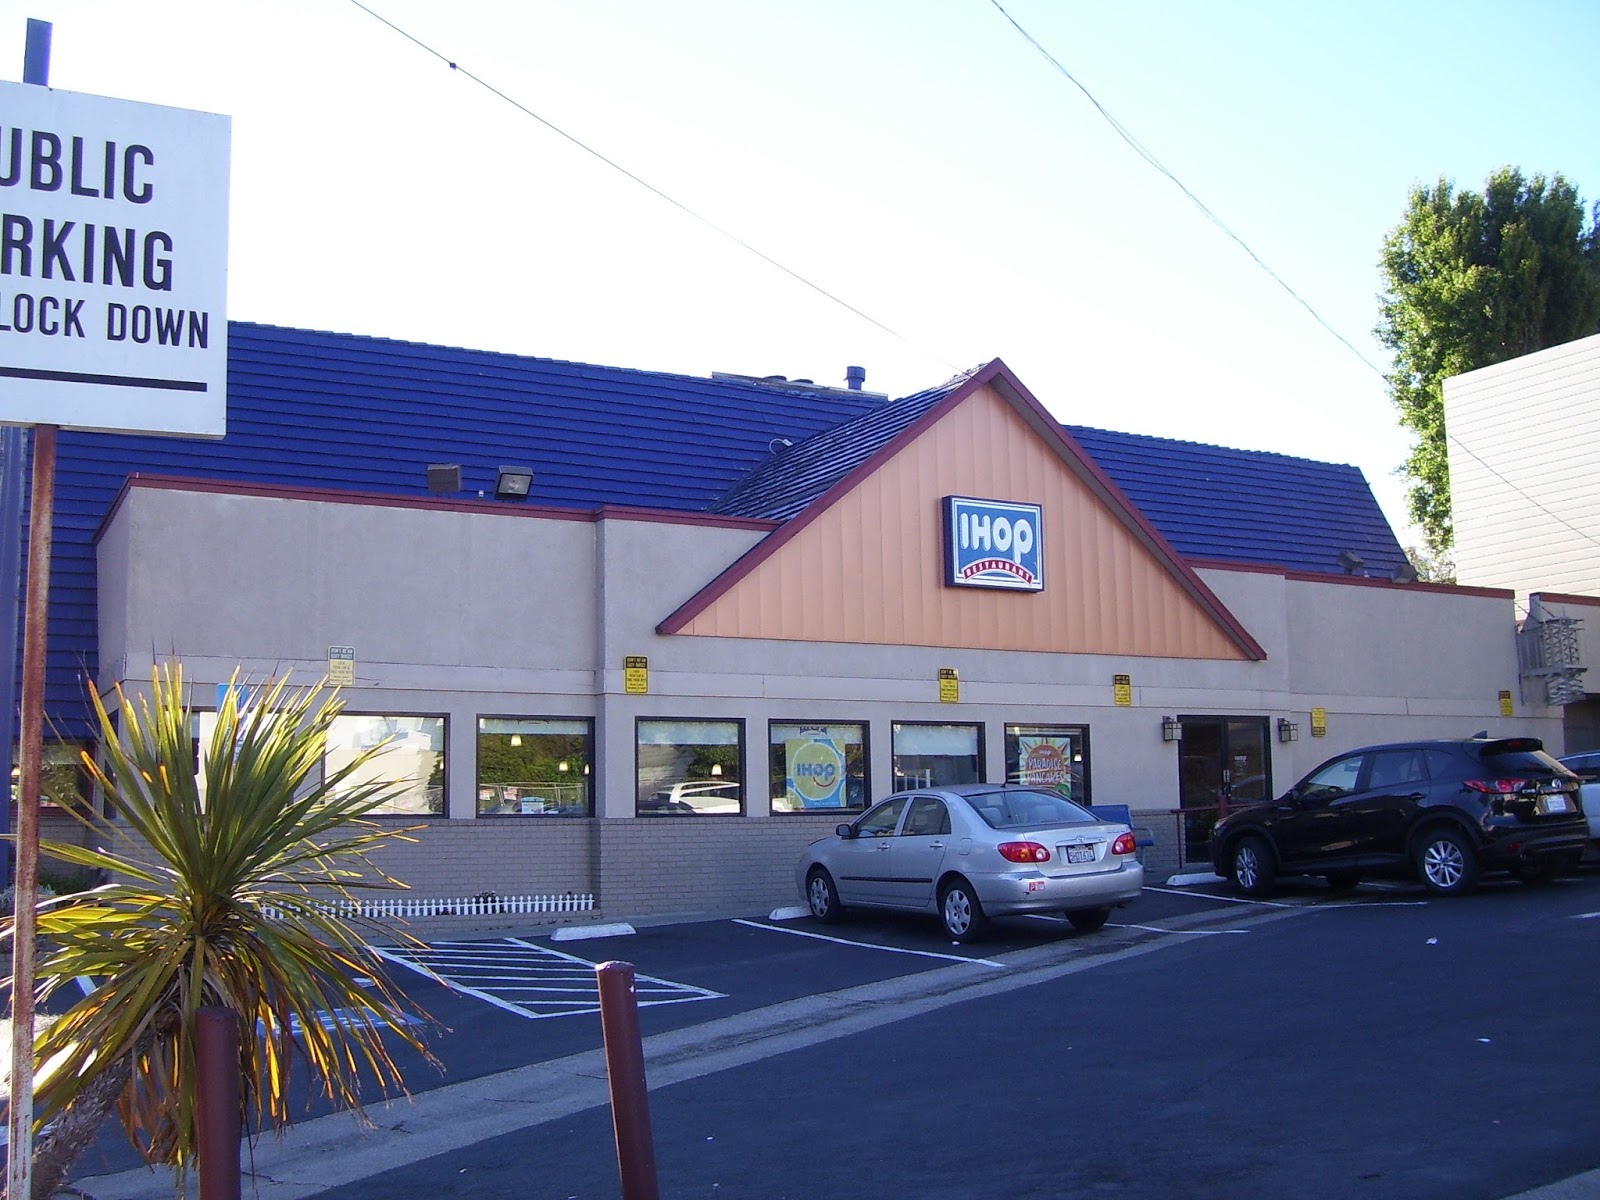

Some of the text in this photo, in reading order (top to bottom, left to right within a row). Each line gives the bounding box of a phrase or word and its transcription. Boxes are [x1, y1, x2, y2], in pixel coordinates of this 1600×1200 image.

[0, 213, 173, 292] RKING
[106, 302, 208, 349] DOWN
[959, 512, 1034, 565] IHOP
[966, 561, 1031, 581] RESTAURANT
[796, 763, 835, 781] IHOP
